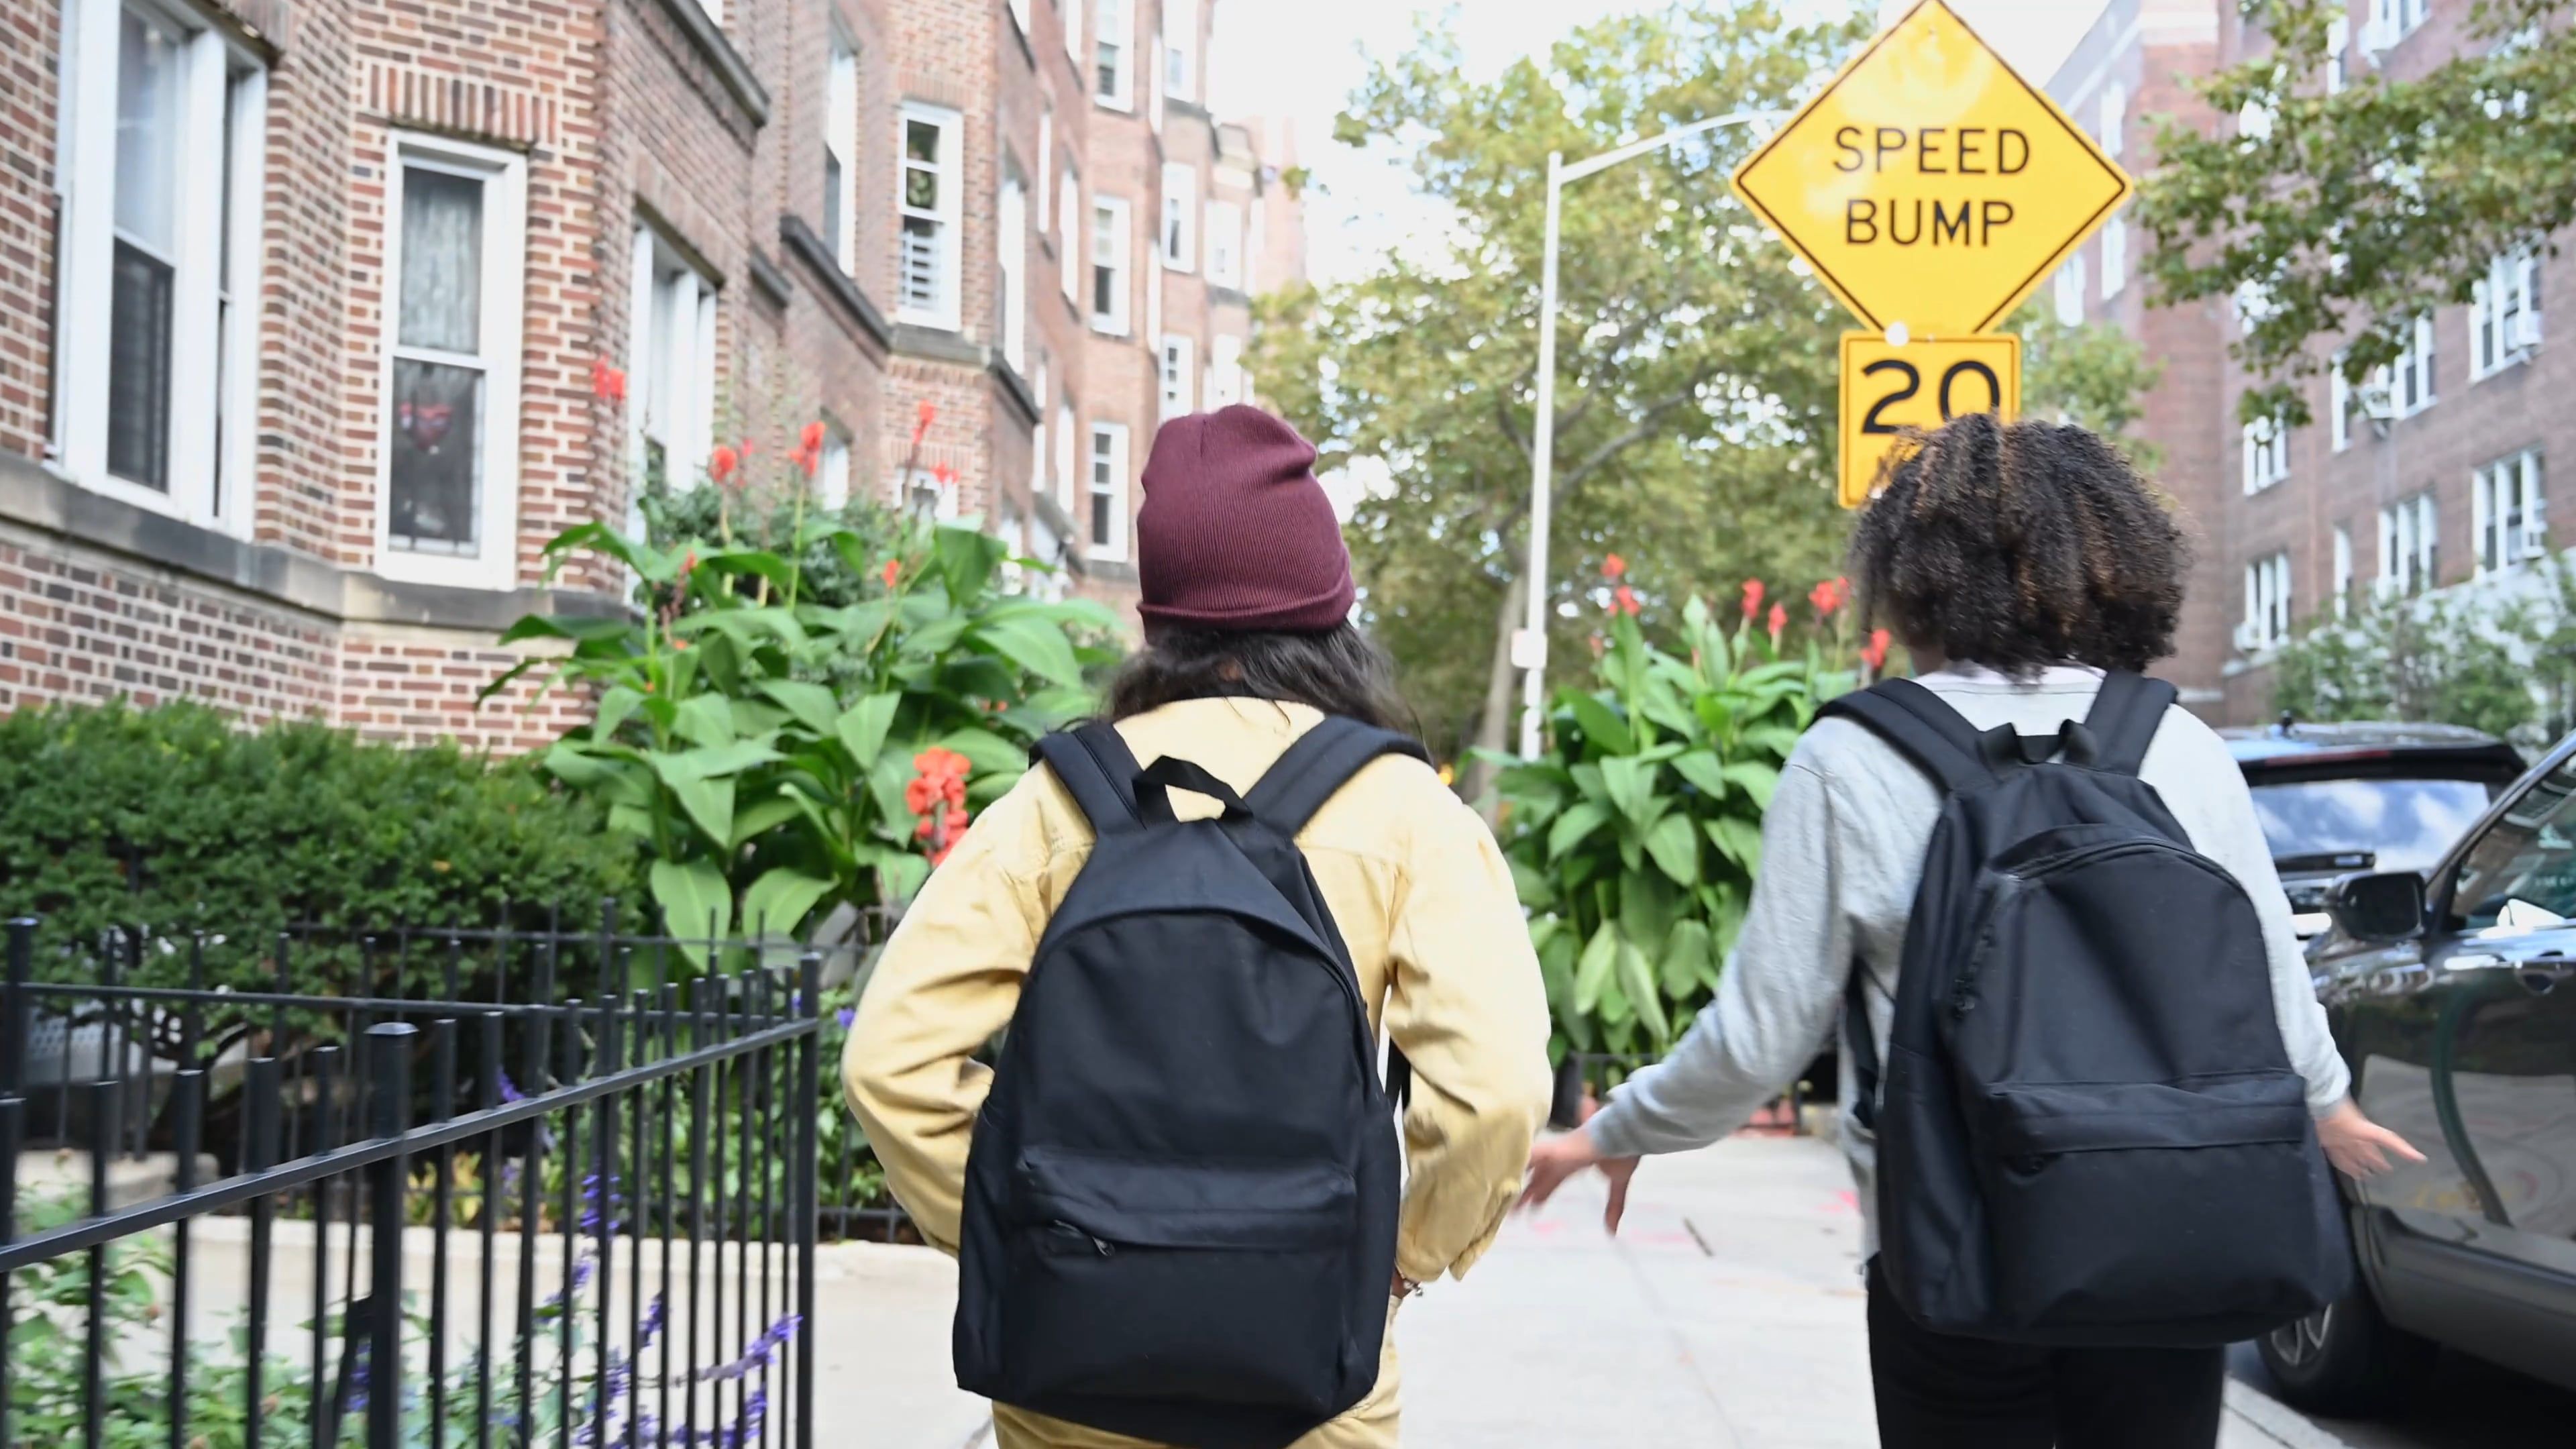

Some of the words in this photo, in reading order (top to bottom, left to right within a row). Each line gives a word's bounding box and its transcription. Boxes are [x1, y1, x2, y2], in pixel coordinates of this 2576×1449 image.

[1833, 127, 2029, 174] SPEED
[1846, 199, 2014, 246] BUMP
[1861, 359, 2001, 435] 20
